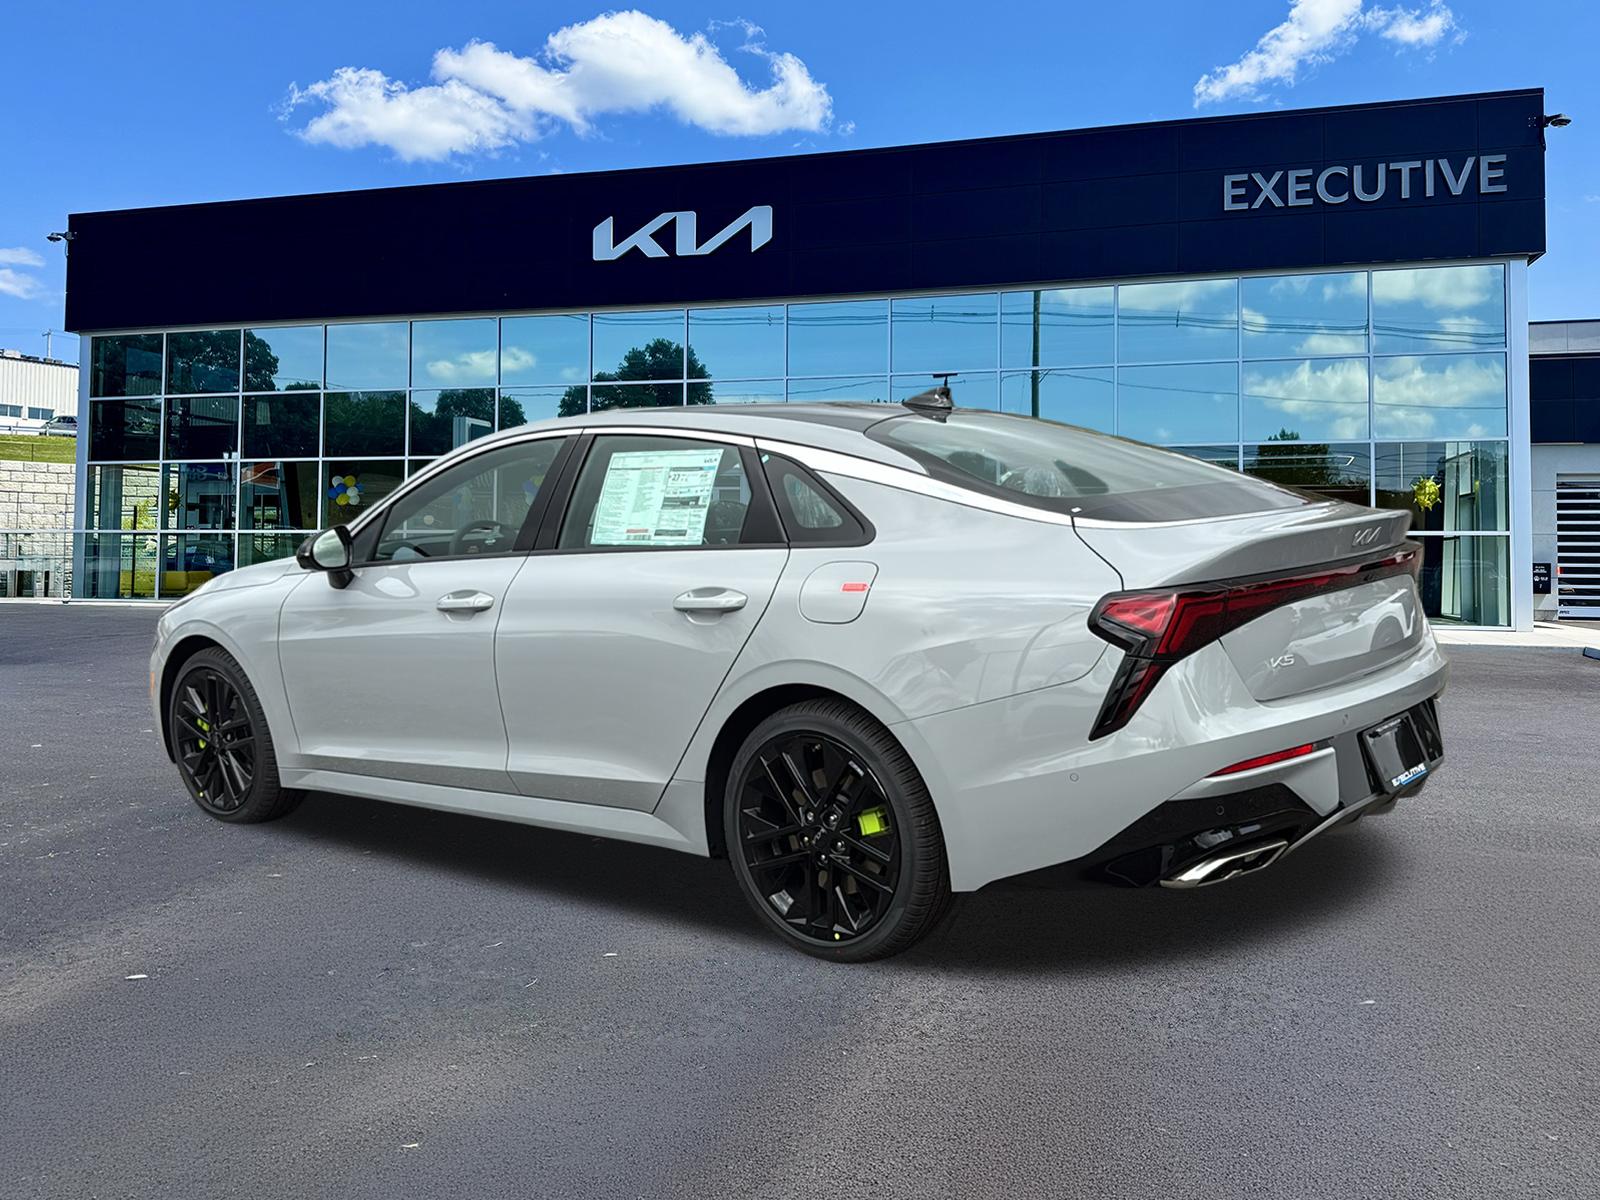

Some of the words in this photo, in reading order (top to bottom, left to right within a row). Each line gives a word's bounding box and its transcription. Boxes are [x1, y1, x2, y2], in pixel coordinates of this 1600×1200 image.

[1223, 154, 1507, 211] EXECUTIVE
[593, 205, 773, 261] KIA
[1270, 654, 1295, 668] K5
